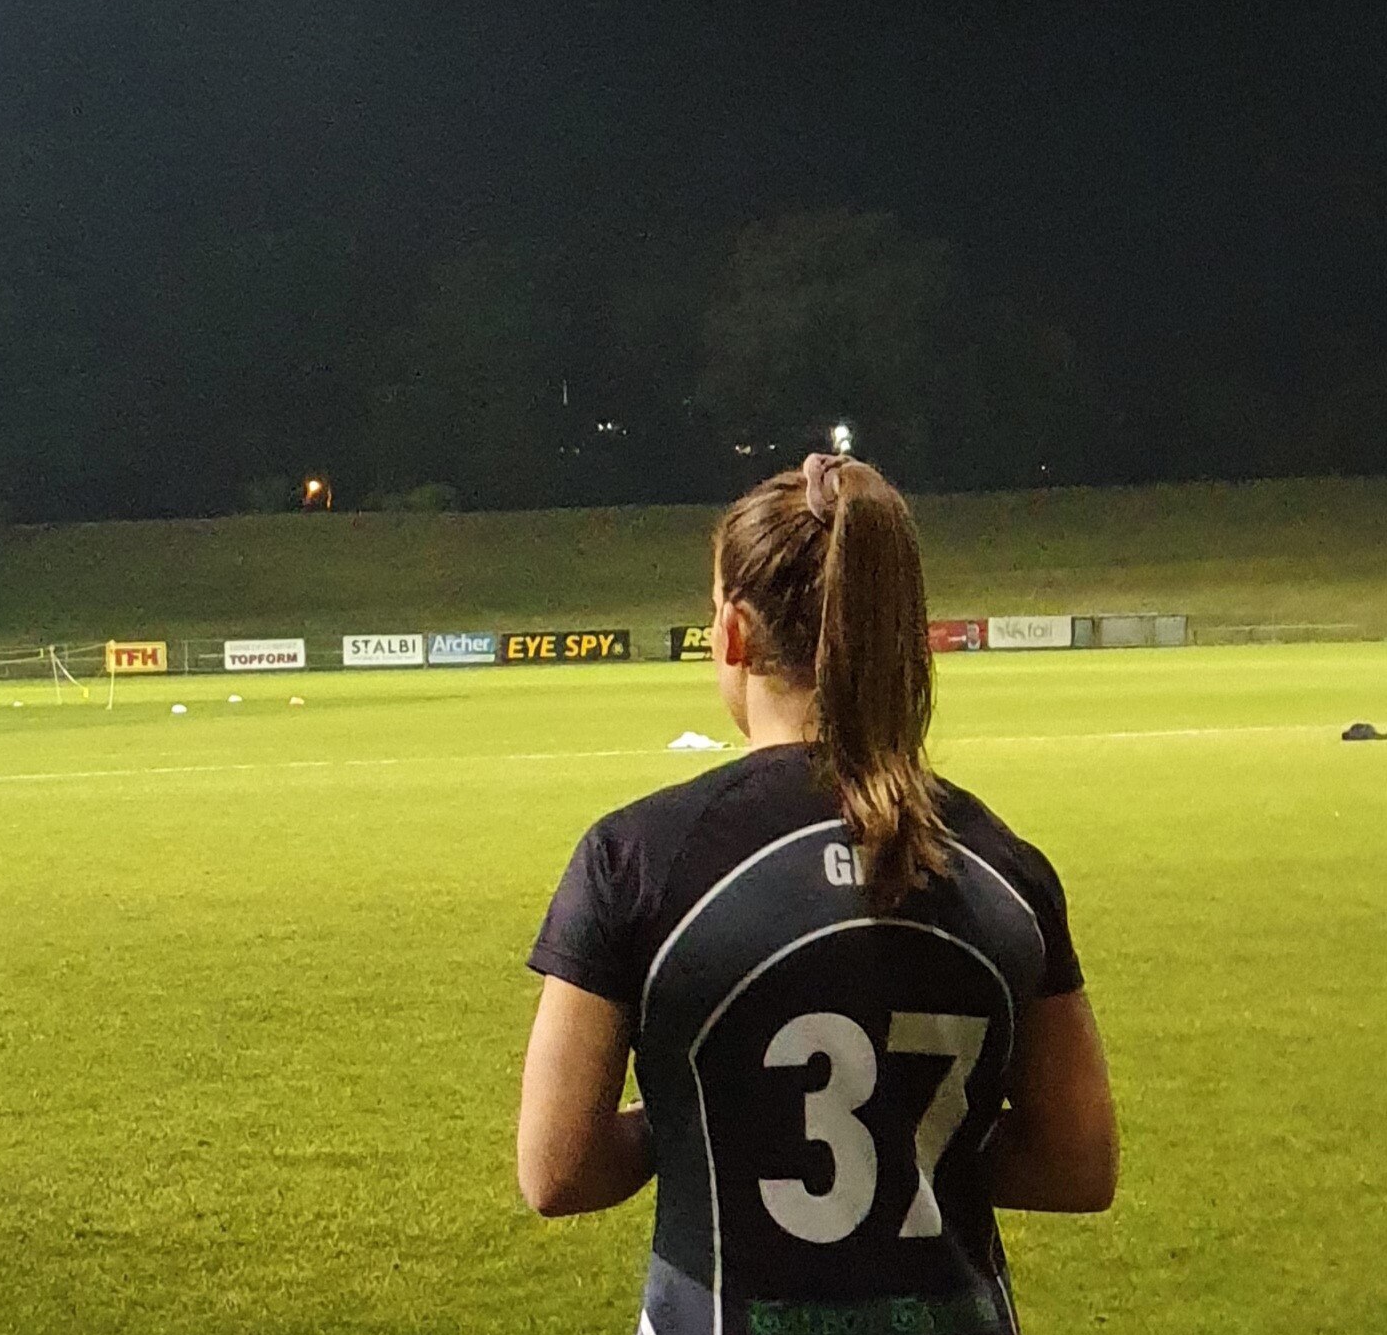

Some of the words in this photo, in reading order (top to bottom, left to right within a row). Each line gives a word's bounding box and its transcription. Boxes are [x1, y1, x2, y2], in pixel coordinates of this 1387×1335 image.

[432, 634, 491, 652] Archer
[508, 636, 557, 659] EYE
[565, 634, 614, 657] SPY
[113, 648, 159, 666] TFH
[229, 653, 298, 665] TOPFORM
[759, 1011, 990, 1244] 37
